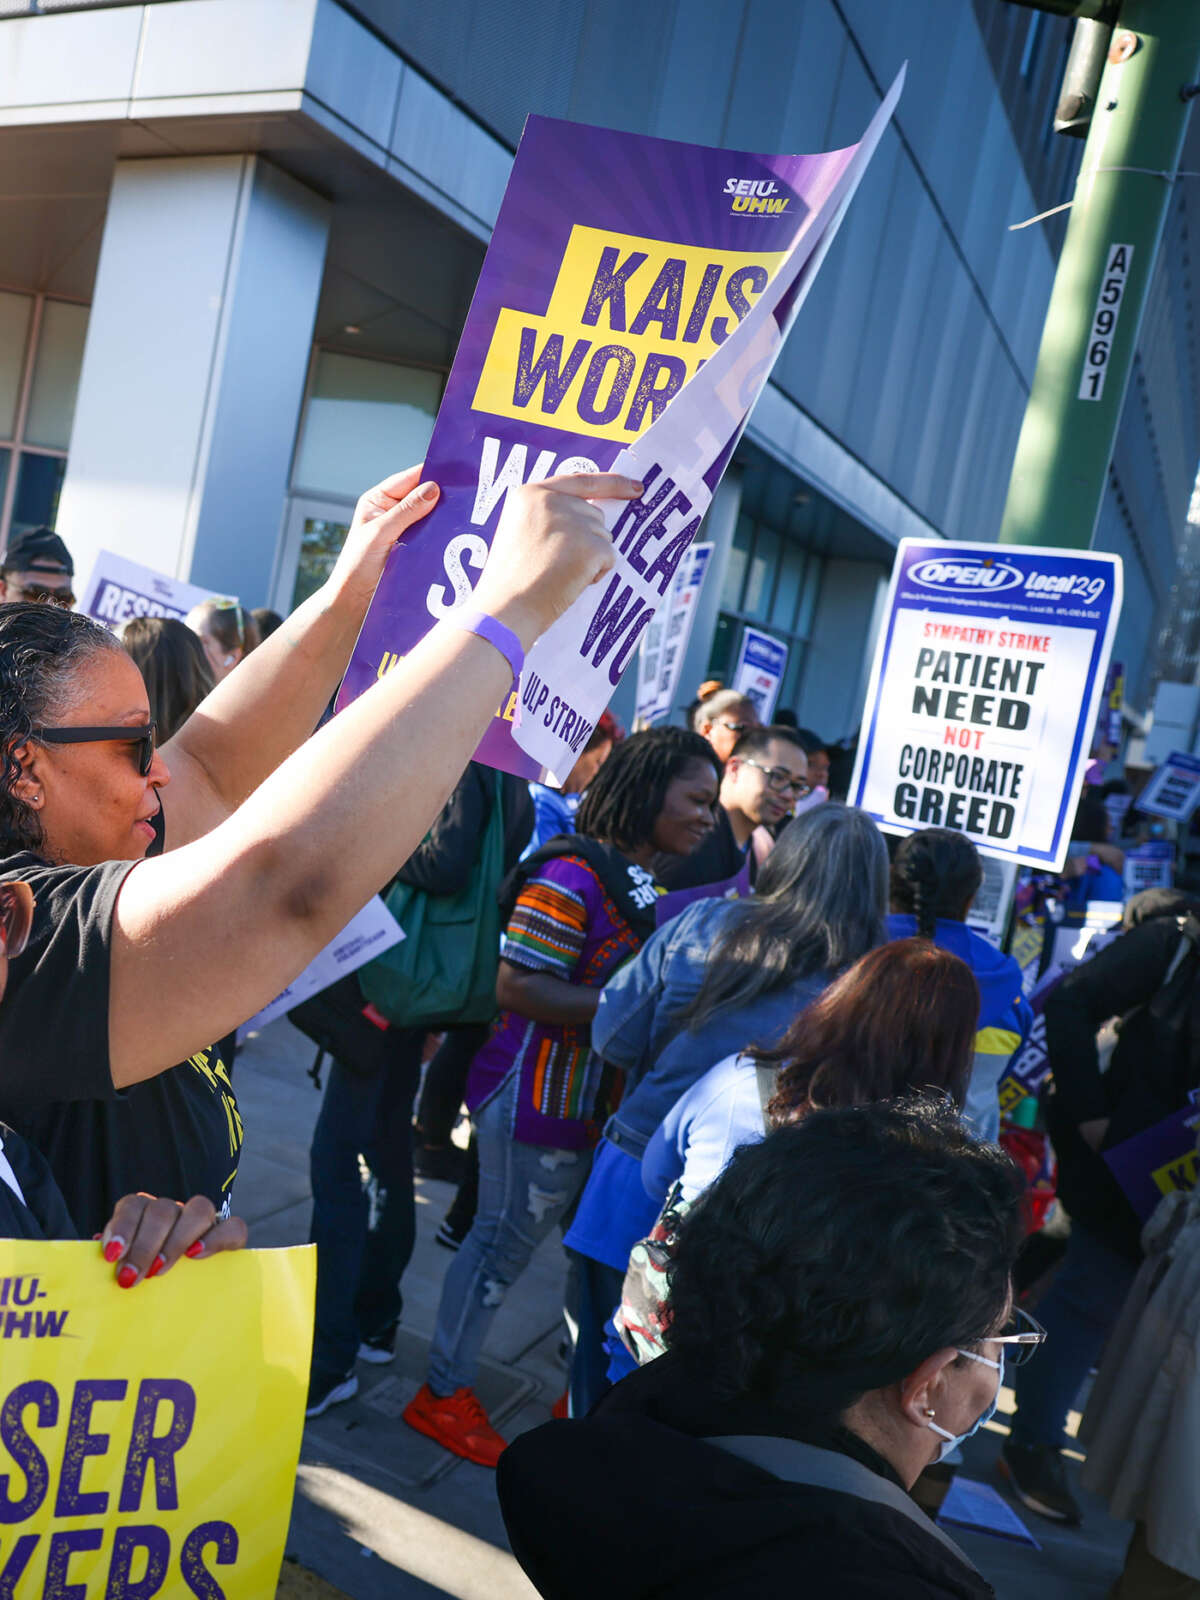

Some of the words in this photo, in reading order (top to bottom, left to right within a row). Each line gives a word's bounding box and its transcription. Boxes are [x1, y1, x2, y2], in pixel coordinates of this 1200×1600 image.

[723, 178, 778, 197] SEIU-
[731, 196, 790, 213] UHW
[1088, 246, 1126, 398] A5961
[512, 327, 707, 433] WOR
[919, 563, 1009, 588] OPEIU
[923, 622, 995, 645] SYMPATHY
[998, 632, 1052, 652] STRIKE
[522, 672, 549, 714] ULP
[914, 647, 1045, 695] PATIENT
[912, 685, 1031, 731] NEED
[944, 725, 985, 750] NOT
[899, 744, 1024, 799] CORPORATE
[893, 782, 1015, 839] GREED
